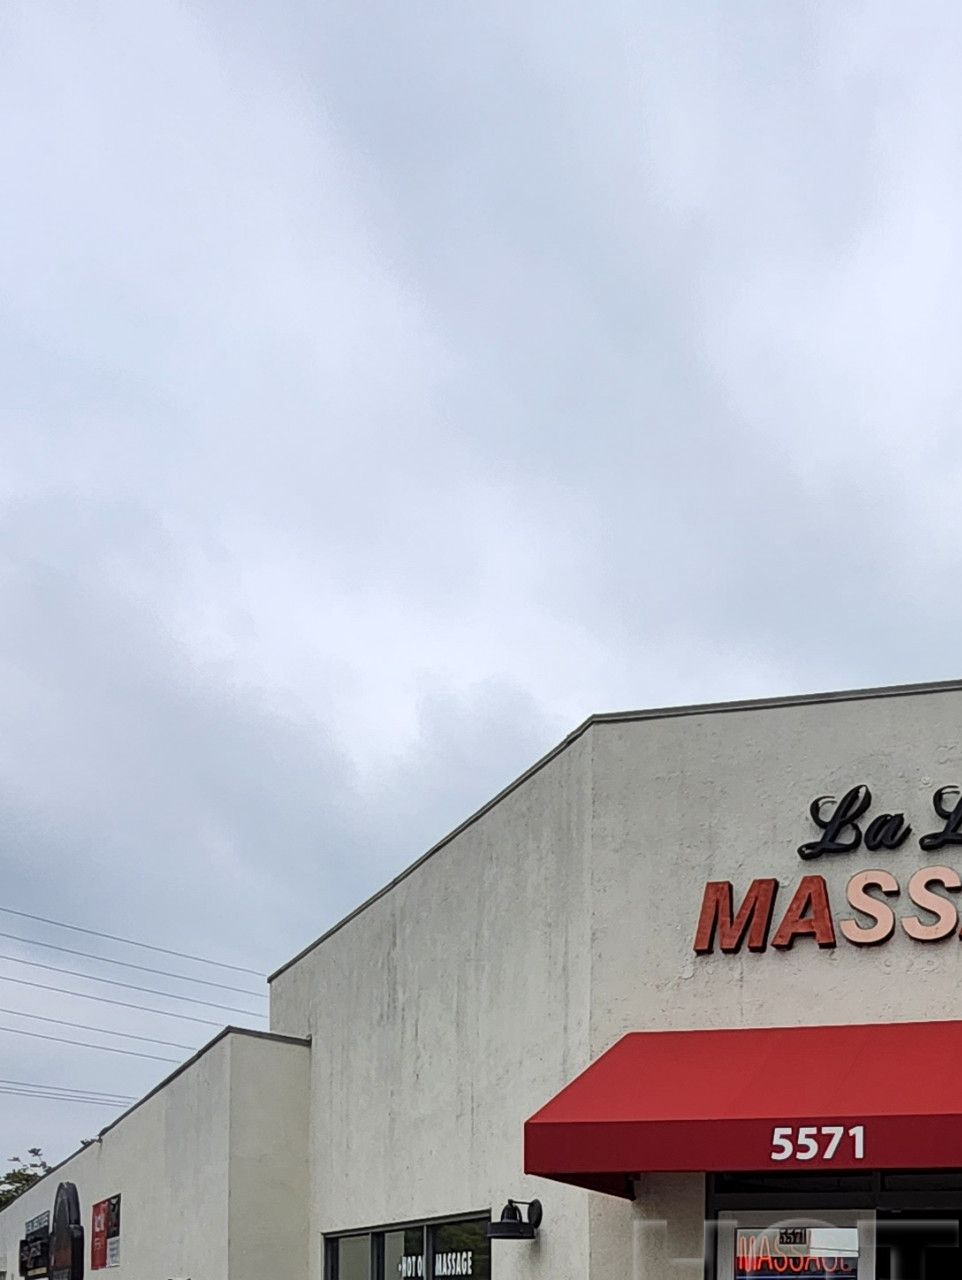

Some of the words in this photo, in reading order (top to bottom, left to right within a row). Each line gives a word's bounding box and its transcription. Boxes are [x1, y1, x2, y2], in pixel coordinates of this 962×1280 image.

[797, 785, 912, 860] La
[770, 1125, 864, 1160] 5571
[402, 1255, 416, 1277] HOT
[435, 1251, 472, 1276] MASSAGE
